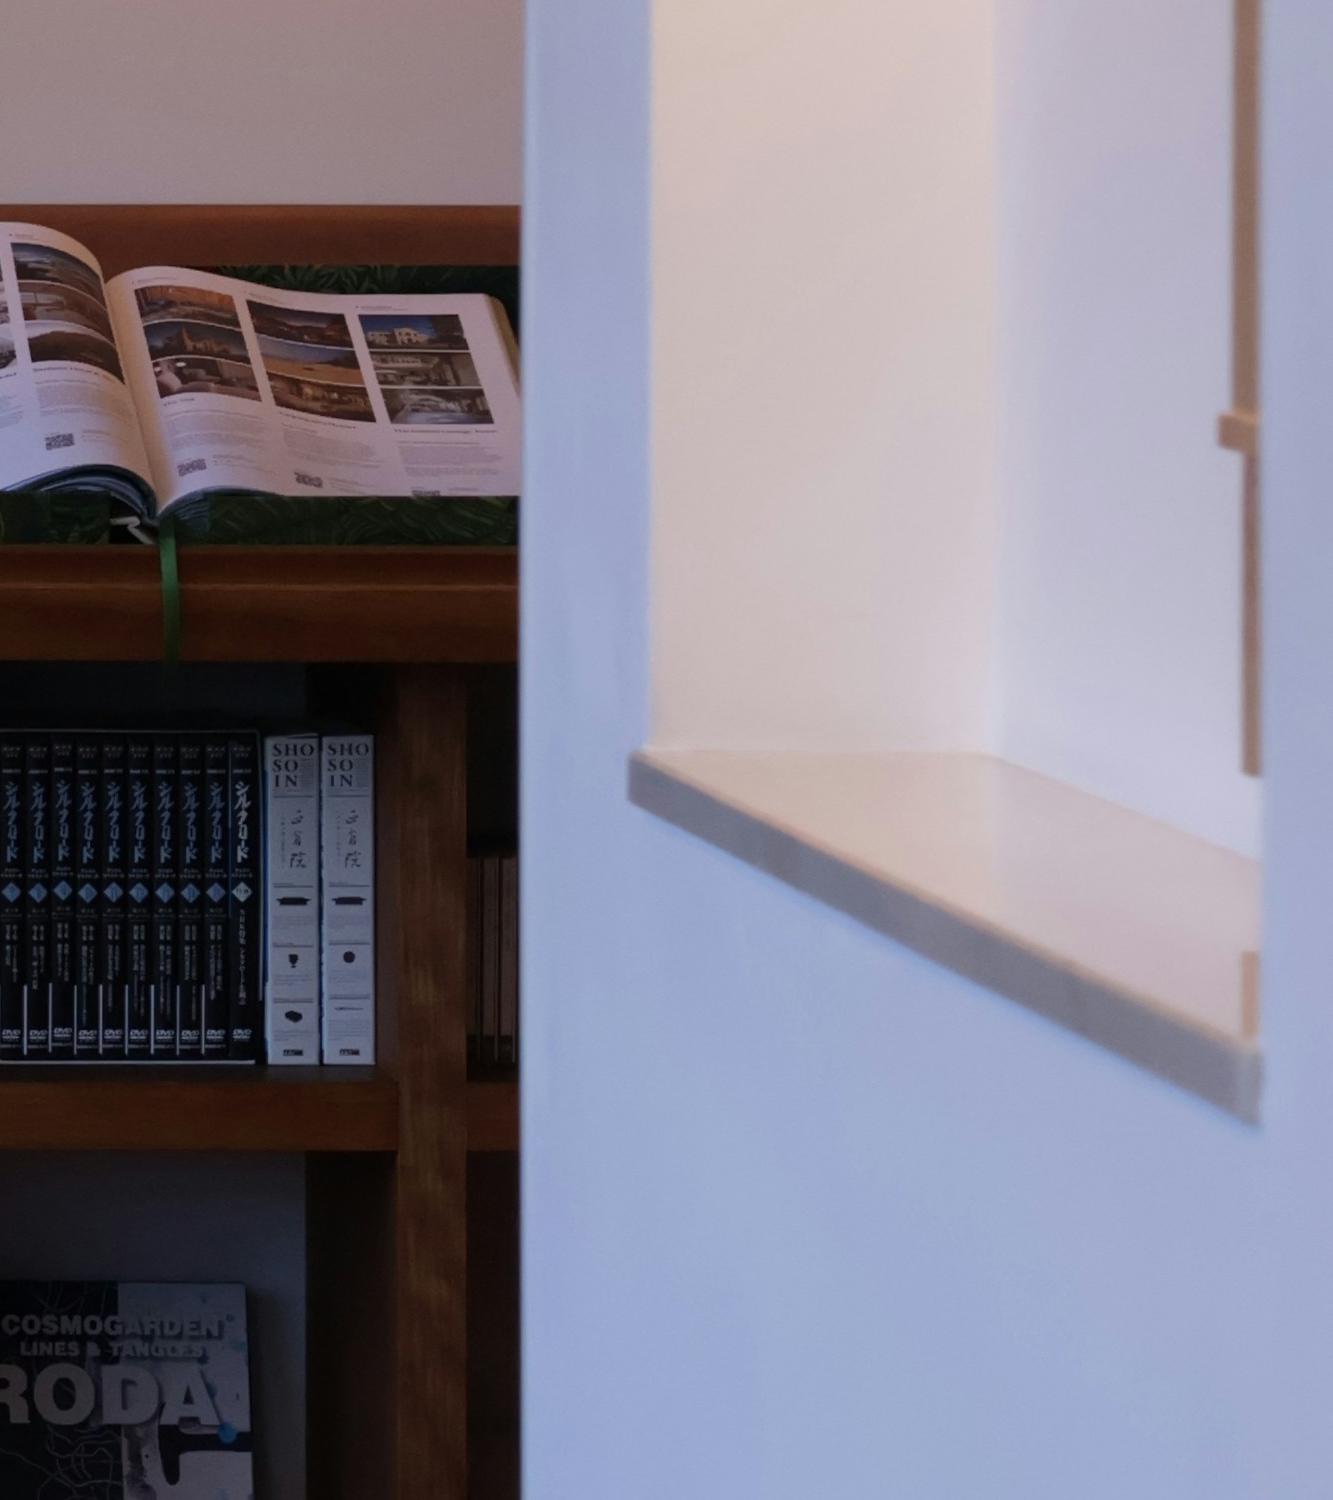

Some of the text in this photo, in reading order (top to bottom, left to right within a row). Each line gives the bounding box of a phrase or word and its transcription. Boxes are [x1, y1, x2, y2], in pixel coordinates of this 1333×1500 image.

[272, 743, 314, 758] SHO
[273, 758, 299, 773] SO
[274, 774, 299, 788] IN
[326, 743, 370, 758] SHO
[327, 758, 354, 773] SO
[328, 774, 354, 788] IN
[4, 780, 22, 863] シルクロード
[30, 780, 47, 863] シルクロード
[55, 778, 73, 862] シルクロード
[78, 780, 97, 864] シルクロード
[104, 780, 123, 864] シルクロード
[130, 780, 149, 864] シルクロード
[156, 780, 175, 864] シルクロード
[181, 780, 200, 864] シルクロード
[207, 780, 226, 864] シルクロード
[234, 780, 252, 865] シルクロード
[2, 1313, 225, 1339] COSMOGARDEN
[19, 1340, 80, 1358] LINES
[107, 1341, 206, 1359] TANGLES
